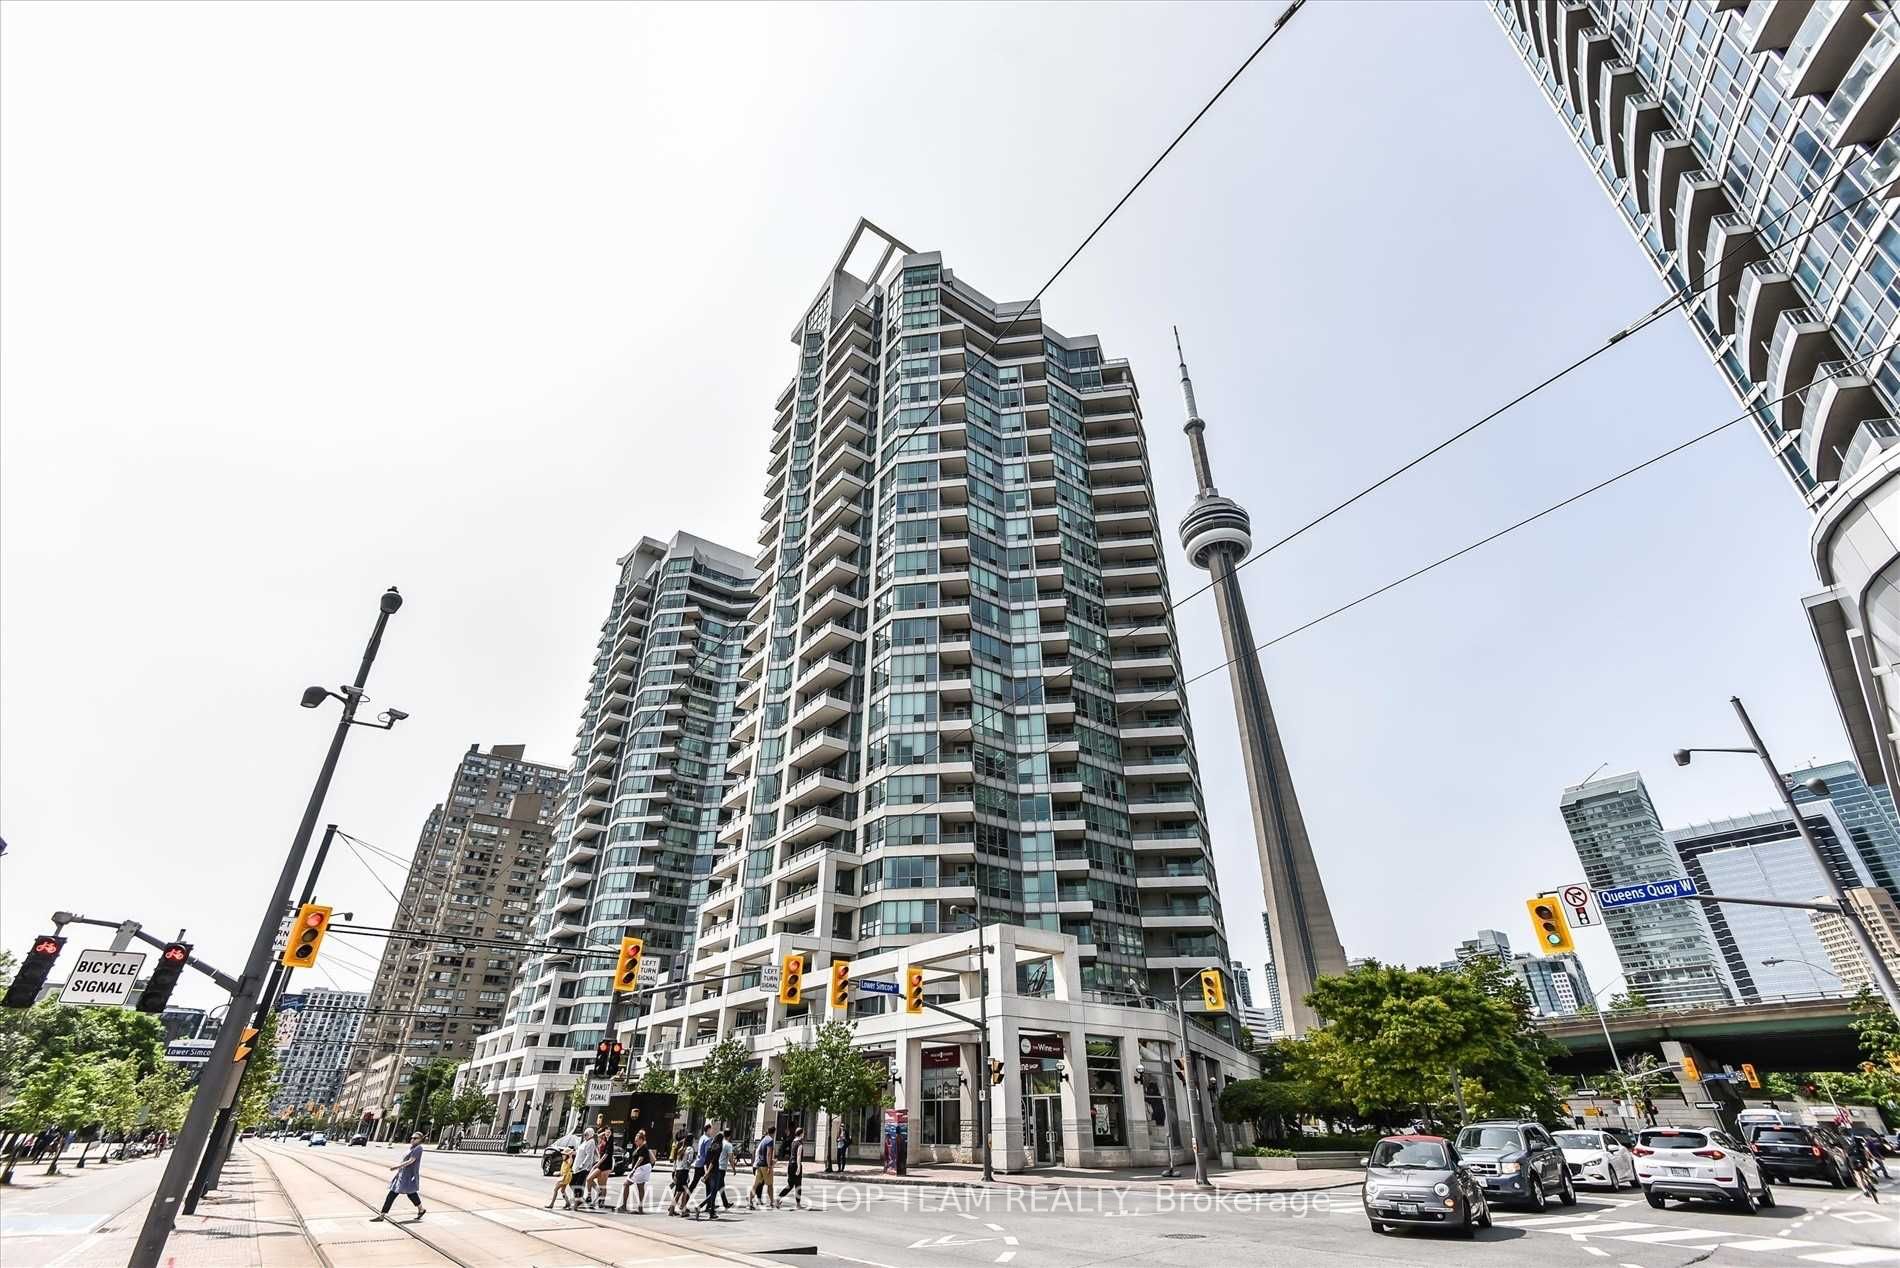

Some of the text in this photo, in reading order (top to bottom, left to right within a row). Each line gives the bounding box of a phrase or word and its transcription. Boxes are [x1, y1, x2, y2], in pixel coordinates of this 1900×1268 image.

[1601, 879, 1692, 903] Queens Quay W
[77, 960, 138, 975] BICYCLE
[640, 966, 657, 974] TURN
[637, 974, 656, 982] SIGNAL
[71, 979, 123, 994] SIGNAL
[861, 980, 893, 992] Lower Simcoe
[190, 1048, 211, 1056] Simco
[1037, 1043, 1053, 1052] Wine
[590, 1093, 607, 1101] SIGNAL
[773, 1099, 784, 1109] 40
